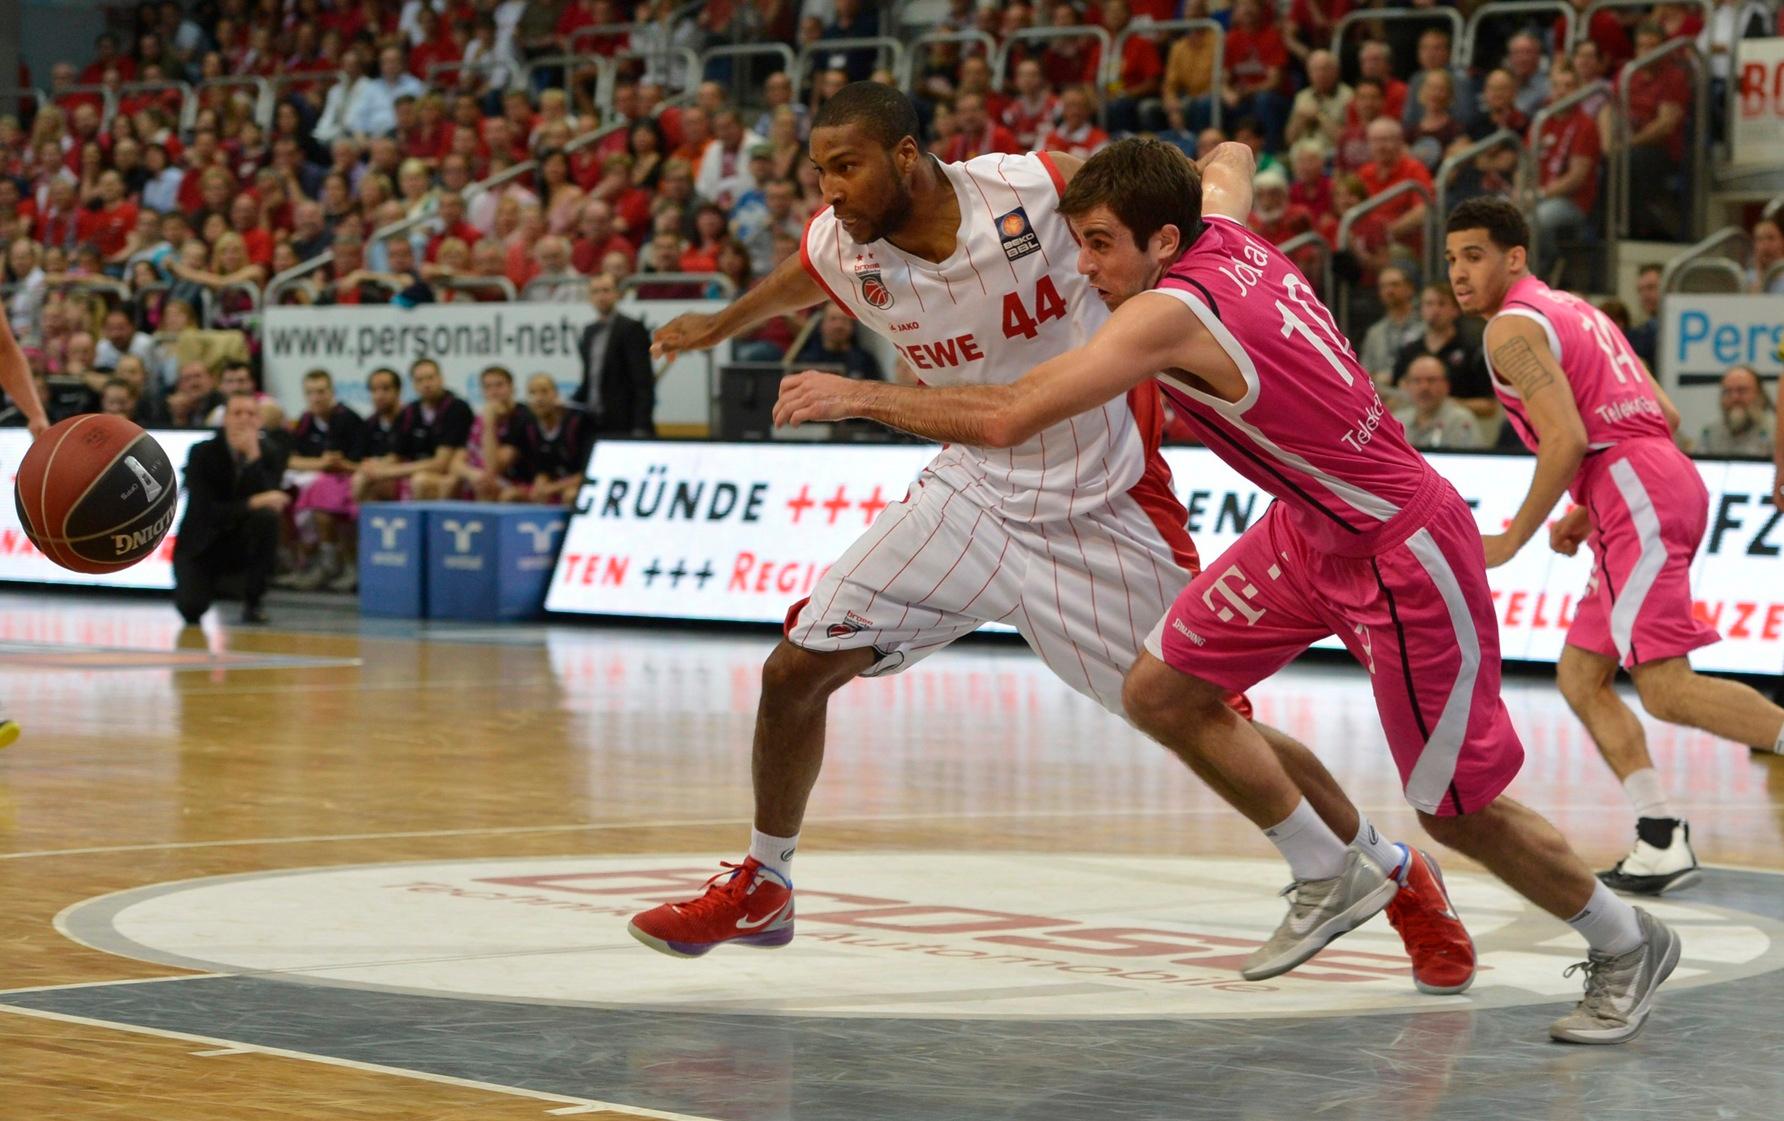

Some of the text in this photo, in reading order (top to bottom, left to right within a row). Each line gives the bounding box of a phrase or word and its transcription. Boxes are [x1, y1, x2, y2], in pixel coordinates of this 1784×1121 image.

[897, 321, 920, 332] JAKO
[1002, 274, 1067, 340] 44
[1580, 310, 1643, 384] 14
[575, 465, 768, 522] GRÜNDE
[564, 554, 630, 586] TEN
[796, 931, 1284, 993] Automobile
